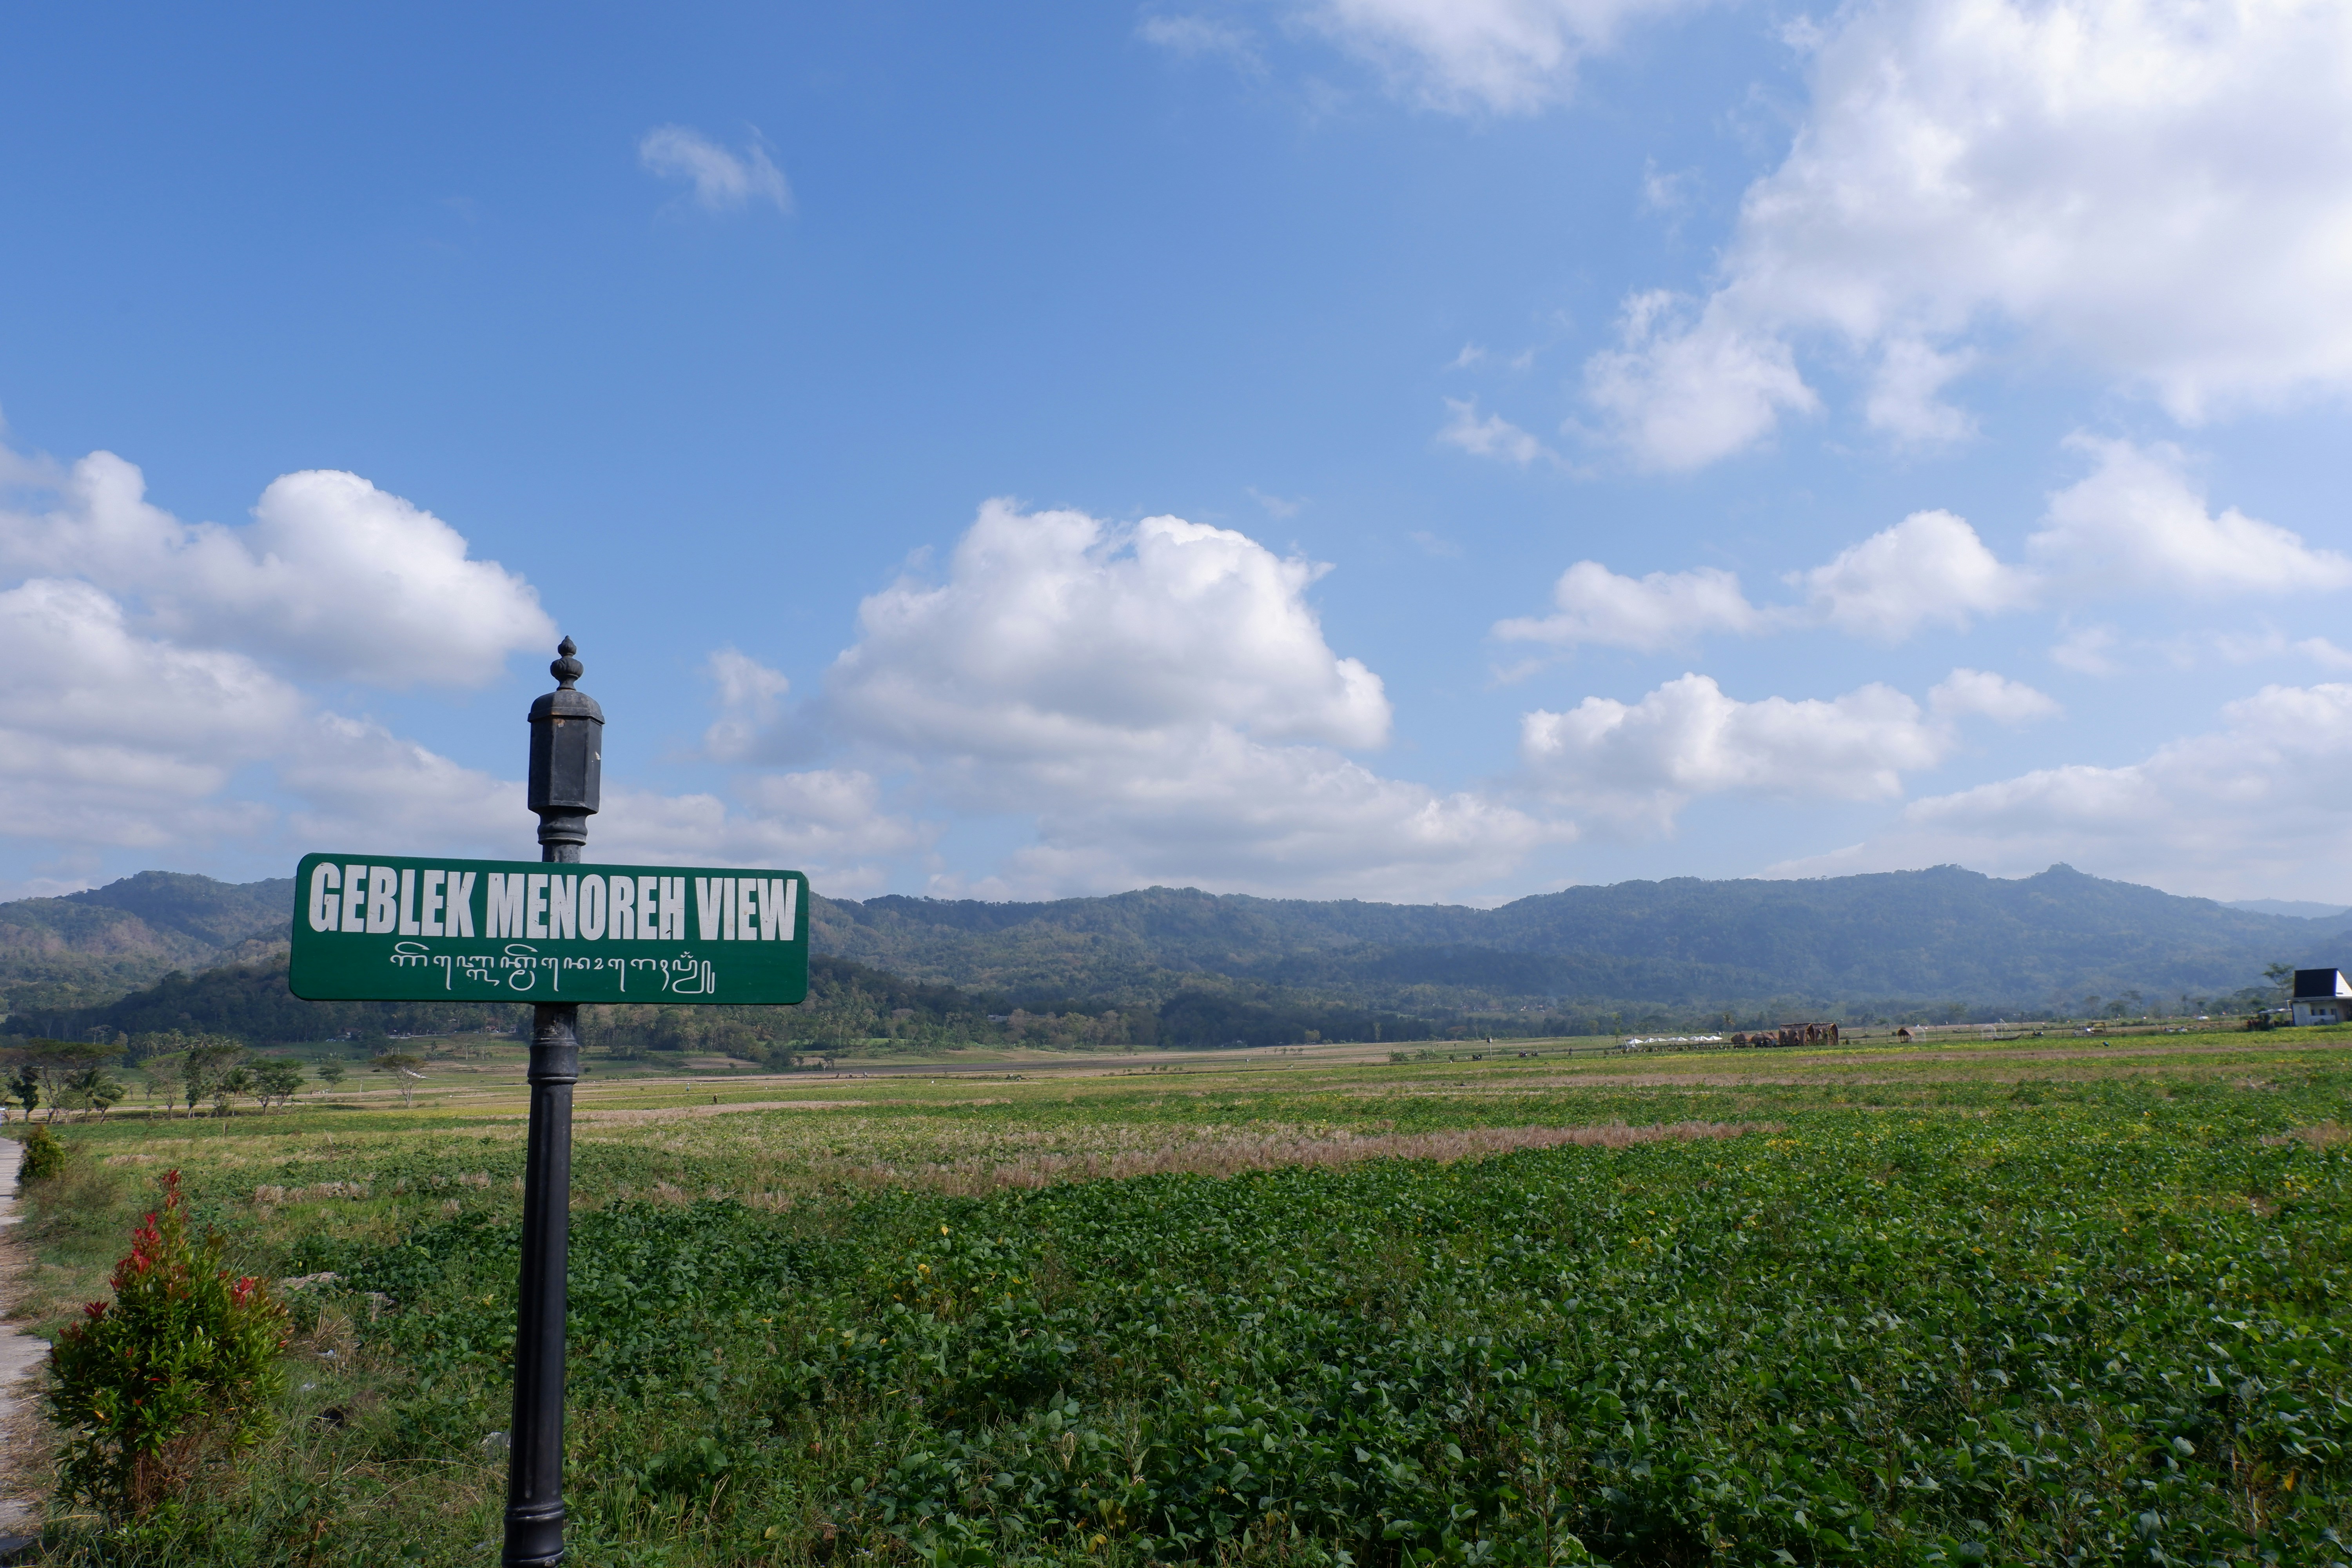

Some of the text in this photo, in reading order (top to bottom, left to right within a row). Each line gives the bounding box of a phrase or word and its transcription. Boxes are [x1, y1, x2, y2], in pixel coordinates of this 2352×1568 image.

[309, 862, 798, 941] GEBLEK MENOREH VIEW
